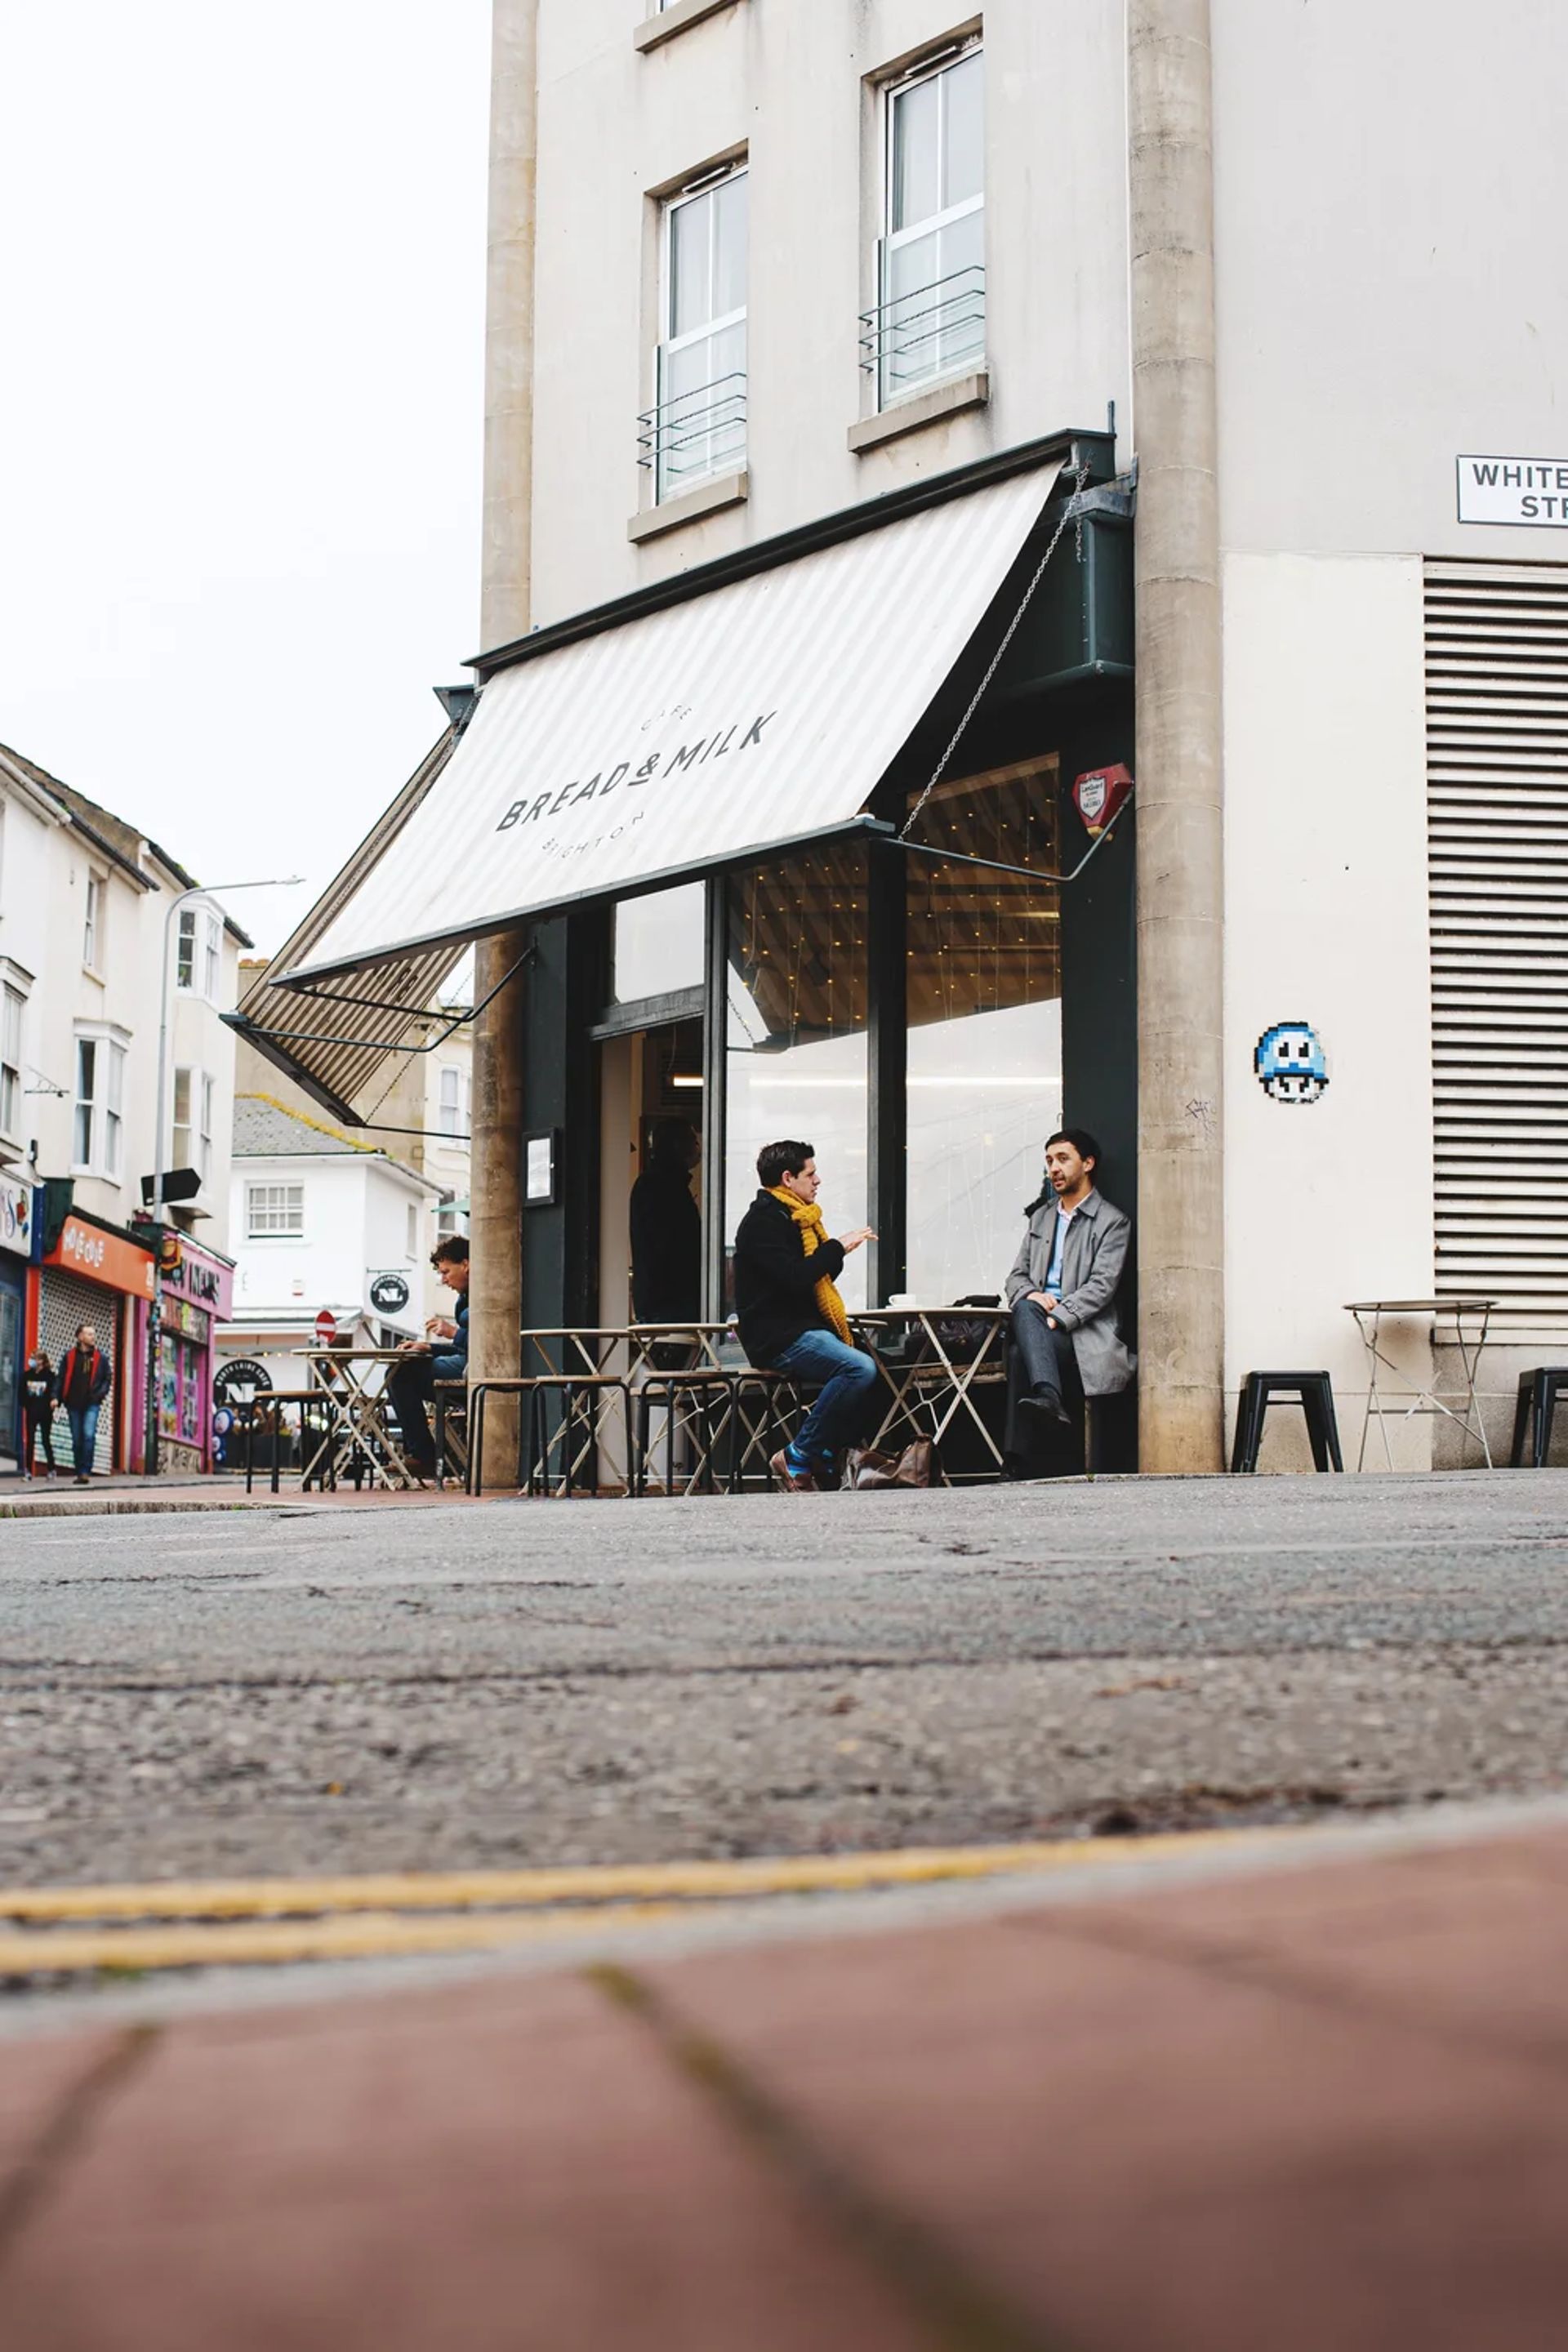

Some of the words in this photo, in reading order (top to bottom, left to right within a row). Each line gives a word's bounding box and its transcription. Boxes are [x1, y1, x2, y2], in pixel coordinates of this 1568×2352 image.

[1472, 463, 1568, 489] WHITE
[495, 761, 630, 831] BREAD
[629, 753, 661, 786] &
[662, 710, 777, 778] MILK
